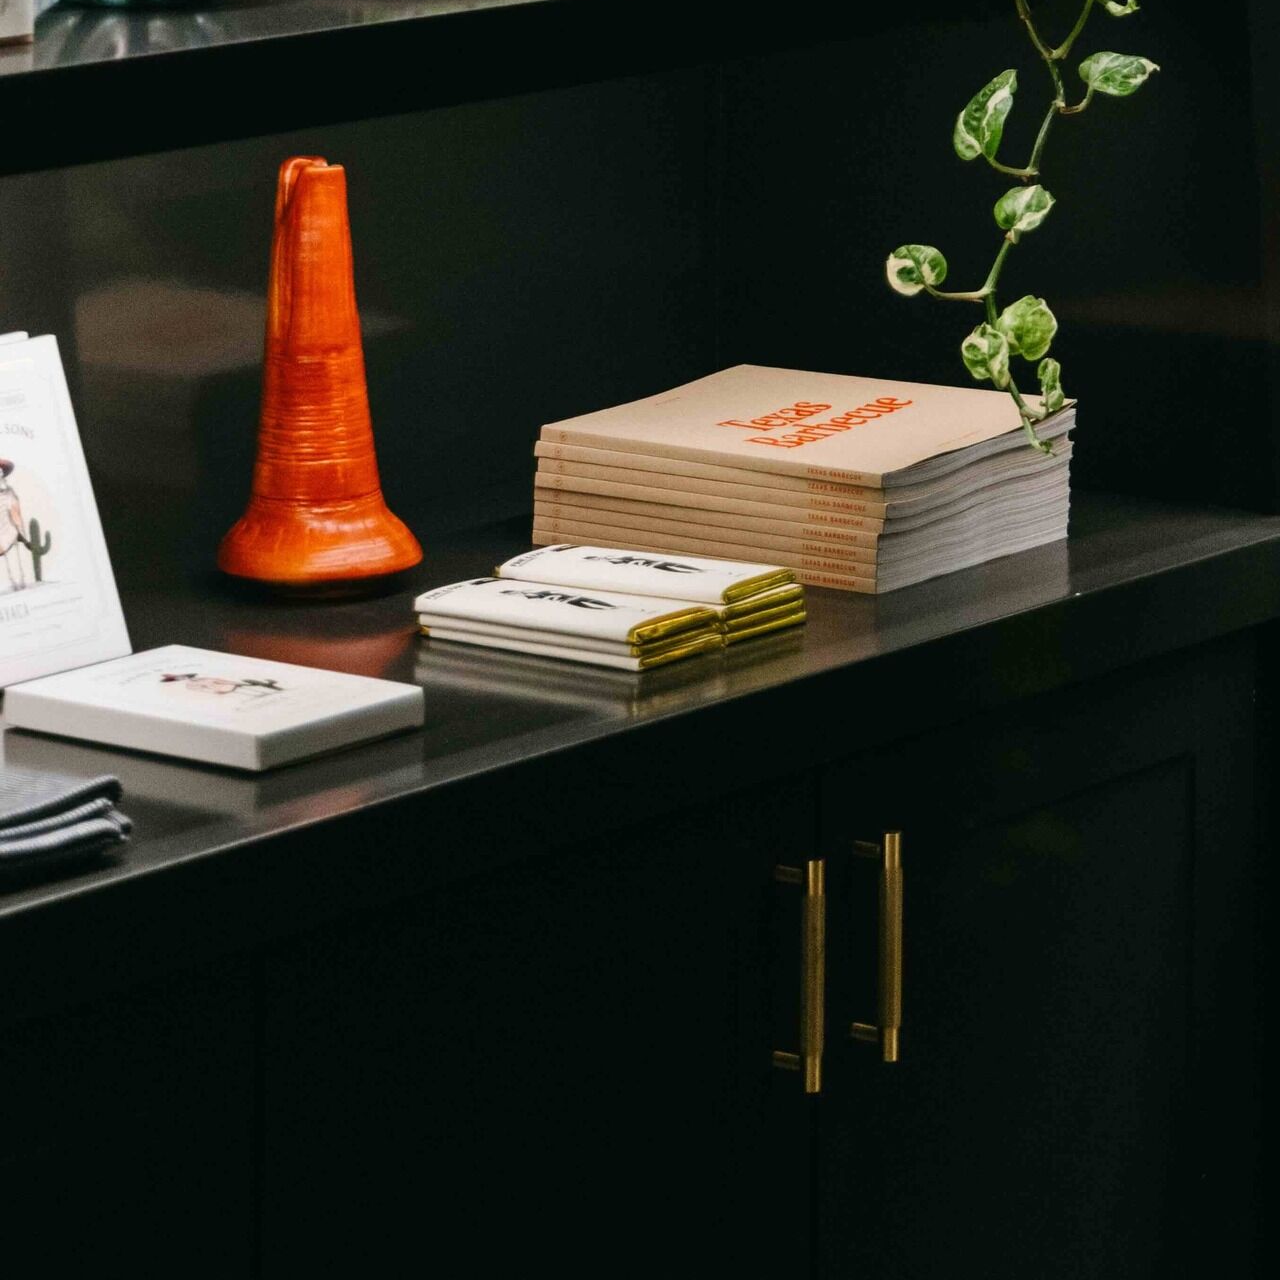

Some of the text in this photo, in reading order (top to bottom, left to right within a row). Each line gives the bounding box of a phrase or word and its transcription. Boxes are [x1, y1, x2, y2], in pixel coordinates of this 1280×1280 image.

[715, 401, 832, 432] Texas
[743, 396, 913, 449] Barbecue
[807, 468, 862, 481] TEXAS BARBECUE
[807, 482, 864, 496] TEXAS BARBECUE
[832, 501, 866, 512] BARBECUE
[807, 513, 863, 527] TEXAS BARBECUE
[802, 528, 858, 541] TEXAS BARBECUE
[802, 544, 857, 557] TEXAS BARBECUE
[801, 558, 856, 571] TEXAS BARBECUE
[822, 576, 856, 587] BARBECUE
